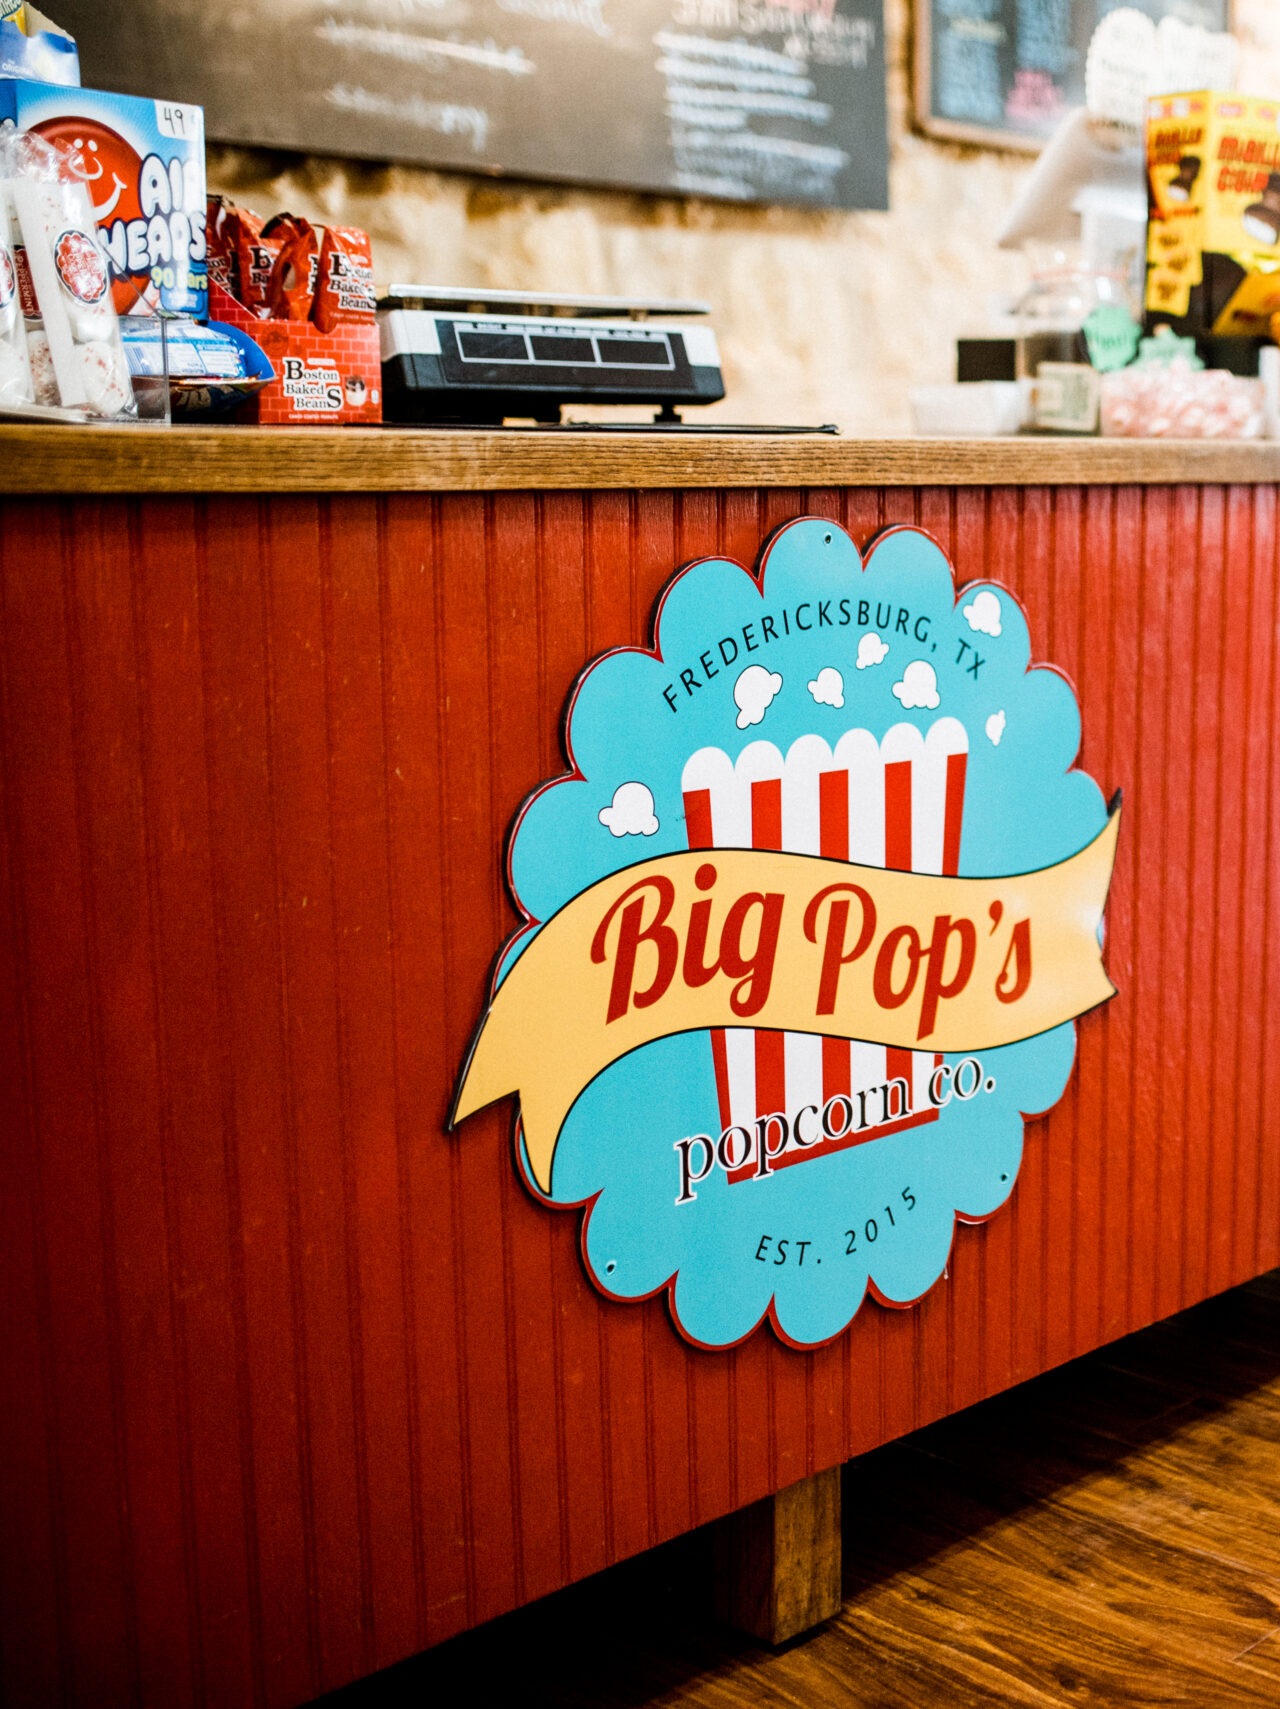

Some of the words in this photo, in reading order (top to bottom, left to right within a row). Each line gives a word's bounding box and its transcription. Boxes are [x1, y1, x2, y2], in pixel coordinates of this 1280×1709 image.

[163, 106, 185, 135] 49
[138, 153, 205, 218] AI
[14, 256, 34, 313] PEPPERMINT
[151, 266, 174, 290] 90
[285, 359, 338, 381] Boston
[285, 383, 325, 396] Baked
[662, 598, 938, 713] FREDERICKSBURG,
[955, 637, 986, 681] TX
[590, 862, 786, 1026] Big
[802, 881, 1032, 1042] Pop's
[674, 1076, 912, 1205] popcorn
[927, 1056, 997, 1108] co.
[754, 1234, 822, 1267] EST.
[844, 1186, 917, 1256] 2015
